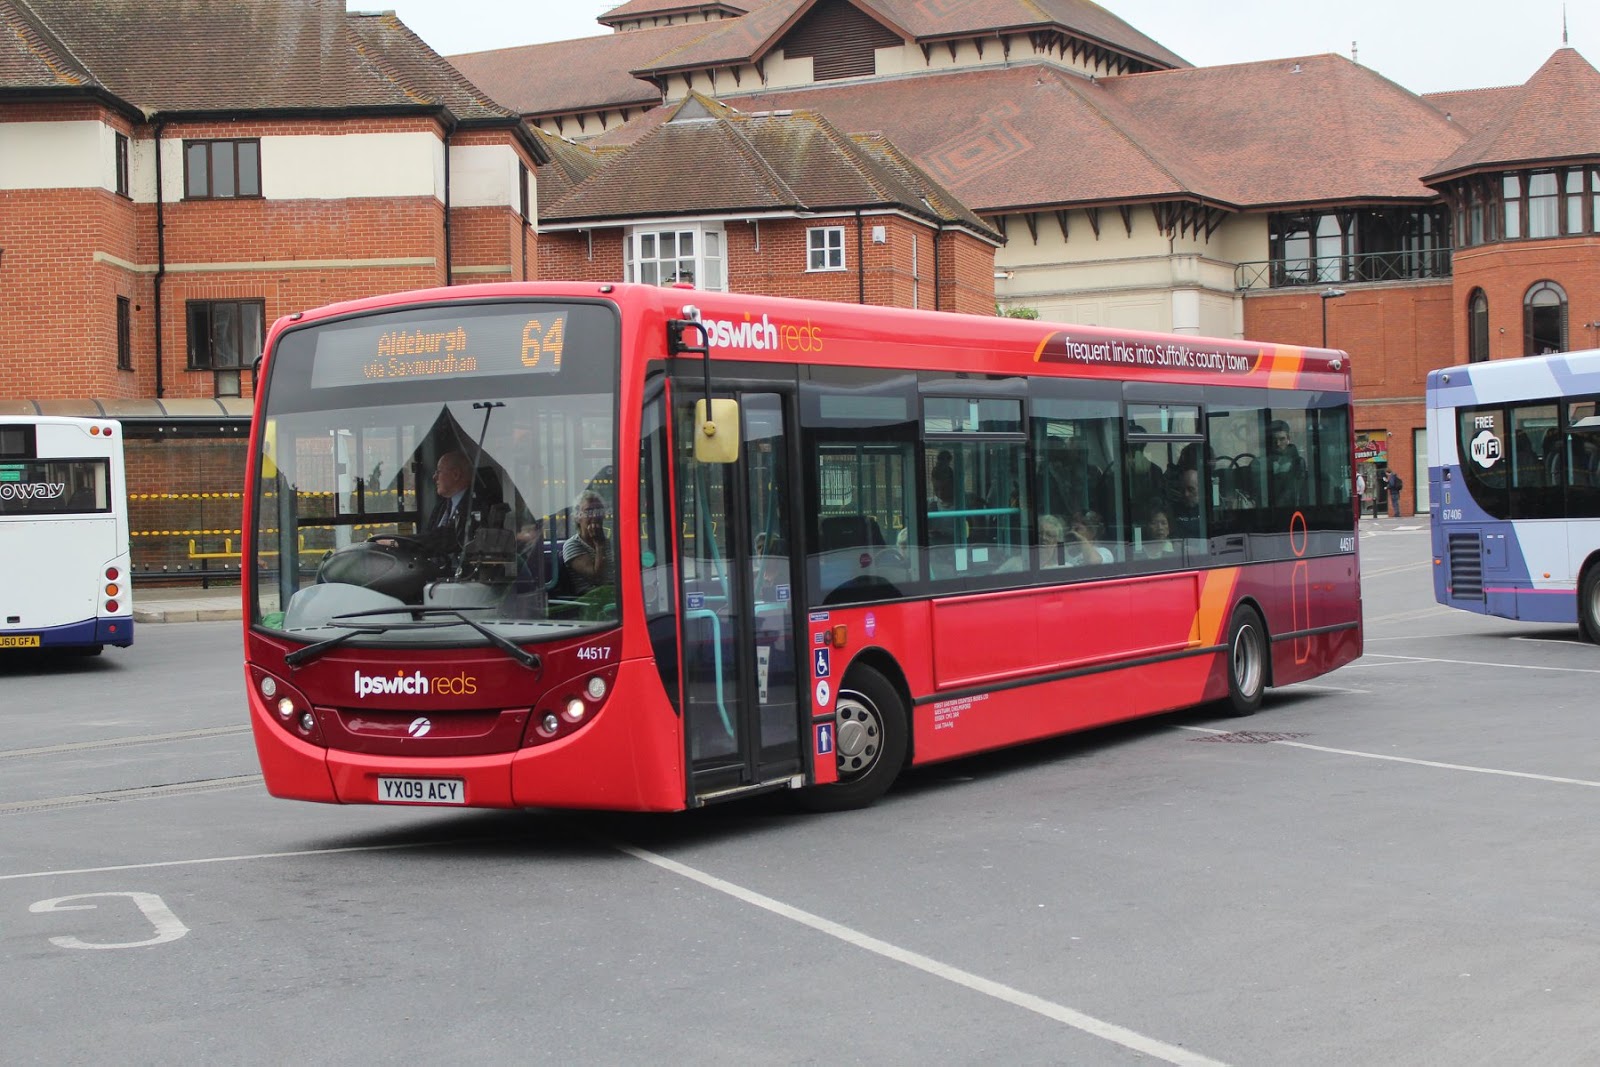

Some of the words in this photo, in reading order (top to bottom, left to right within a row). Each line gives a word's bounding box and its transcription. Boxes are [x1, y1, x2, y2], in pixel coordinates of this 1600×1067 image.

[378, 326, 467, 357] Aldeburgh
[521, 318, 563, 367] 64
[780, 317, 823, 352] reds
[364, 359, 385, 378] via
[388, 353, 477, 377] Saxmundham
[1066, 336, 1111, 364] frequent
[1111, 340, 1135, 363] links
[1135, 343, 1155, 365] into
[1155, 344, 1195, 367] Suffolk's
[1195, 350, 1226, 373] county
[1226, 352, 1249, 371] town
[1474, 415, 1494, 429] FREE
[1443, 509, 1462, 520] 67406
[1340, 537, 1355, 552] 44517
[18, 637, 36, 646] GFA
[577, 647, 611, 660] 44517
[354, 670, 429, 699] Ipswich
[431, 671, 477, 695] reds
[384, 780, 423, 799] YX09
[428, 782, 457, 800] ACY
